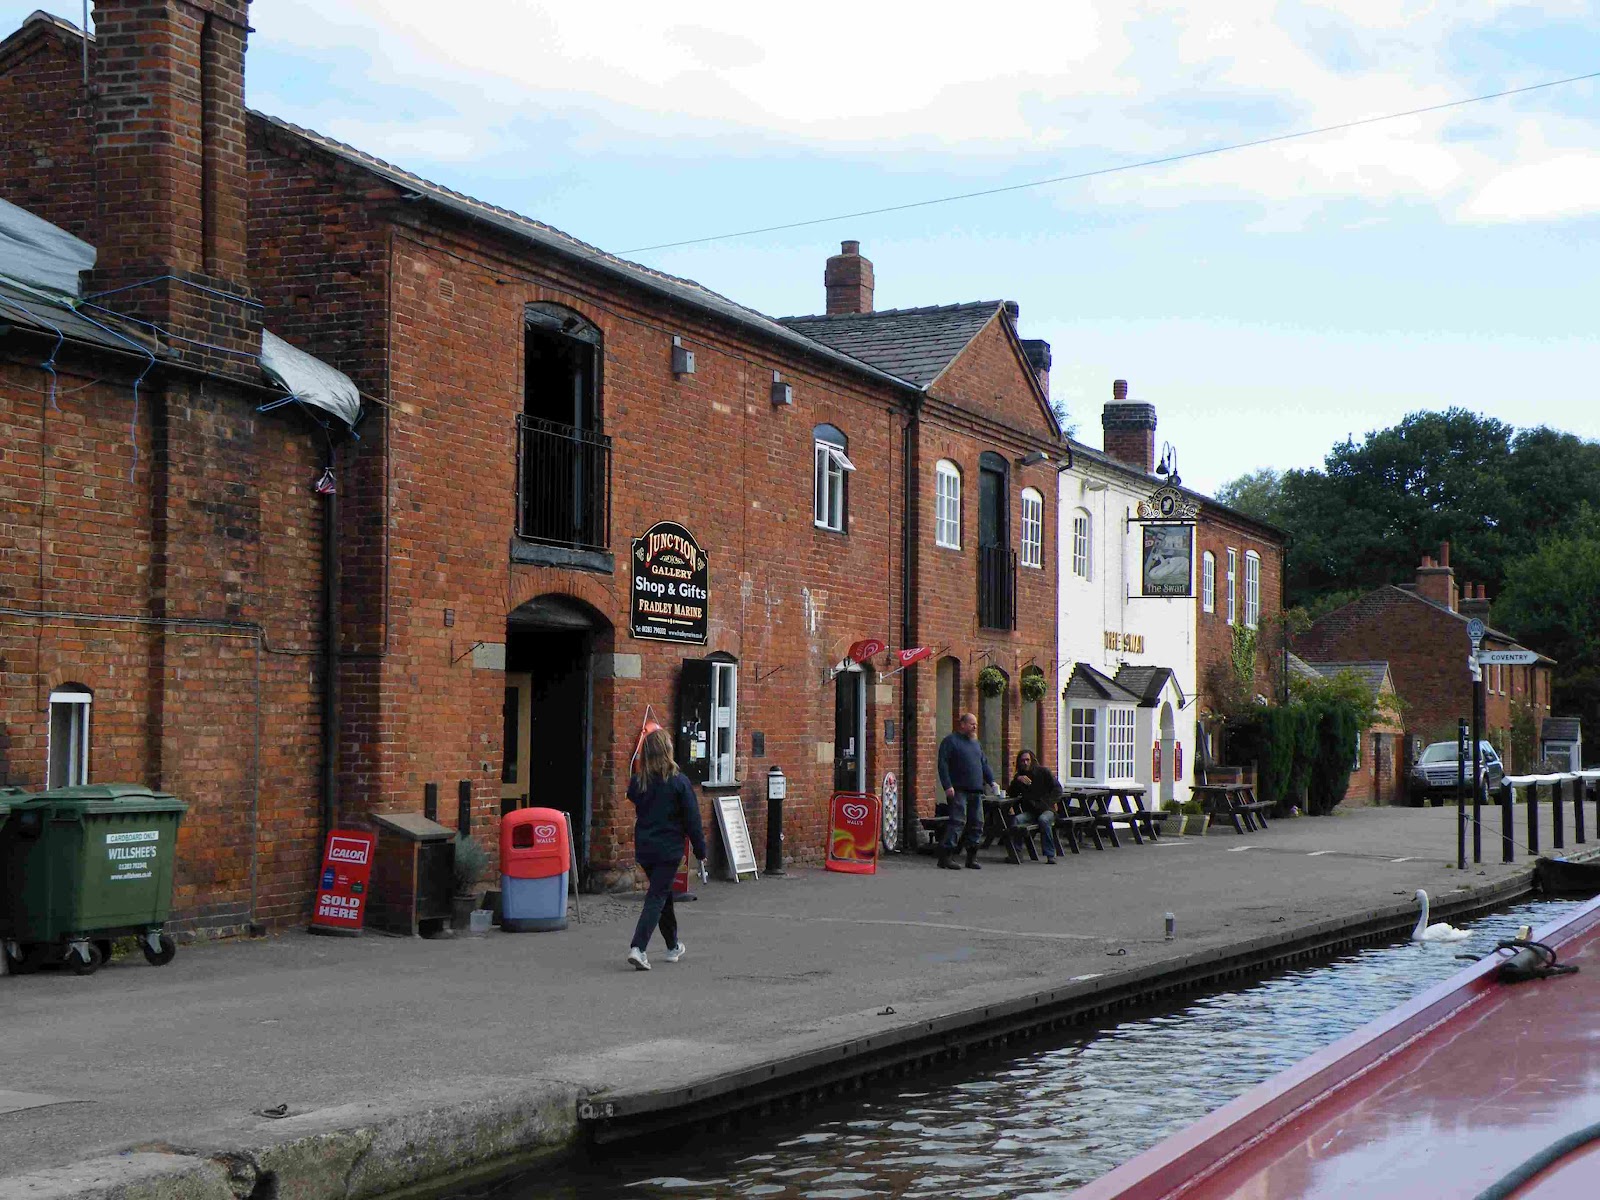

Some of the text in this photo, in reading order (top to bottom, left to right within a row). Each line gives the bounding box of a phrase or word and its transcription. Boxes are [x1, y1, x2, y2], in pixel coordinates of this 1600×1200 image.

[646, 532, 697, 571] JUNCTION
[651, 564, 693, 580] GALLERY
[635, 575, 707, 600] Shop & Gifts
[1147, 583, 1186, 593] The Swan
[638, 598, 703, 618] FRADLEY MARINE
[1104, 630, 1122, 651] THE
[110, 832, 156, 842] CARDBOARD ONLY
[108, 845, 157, 860] WILLSHEE'S
[332, 847, 365, 860] CALOR
[321, 894, 360, 908] SOLD
[319, 905, 359, 920] HERE
